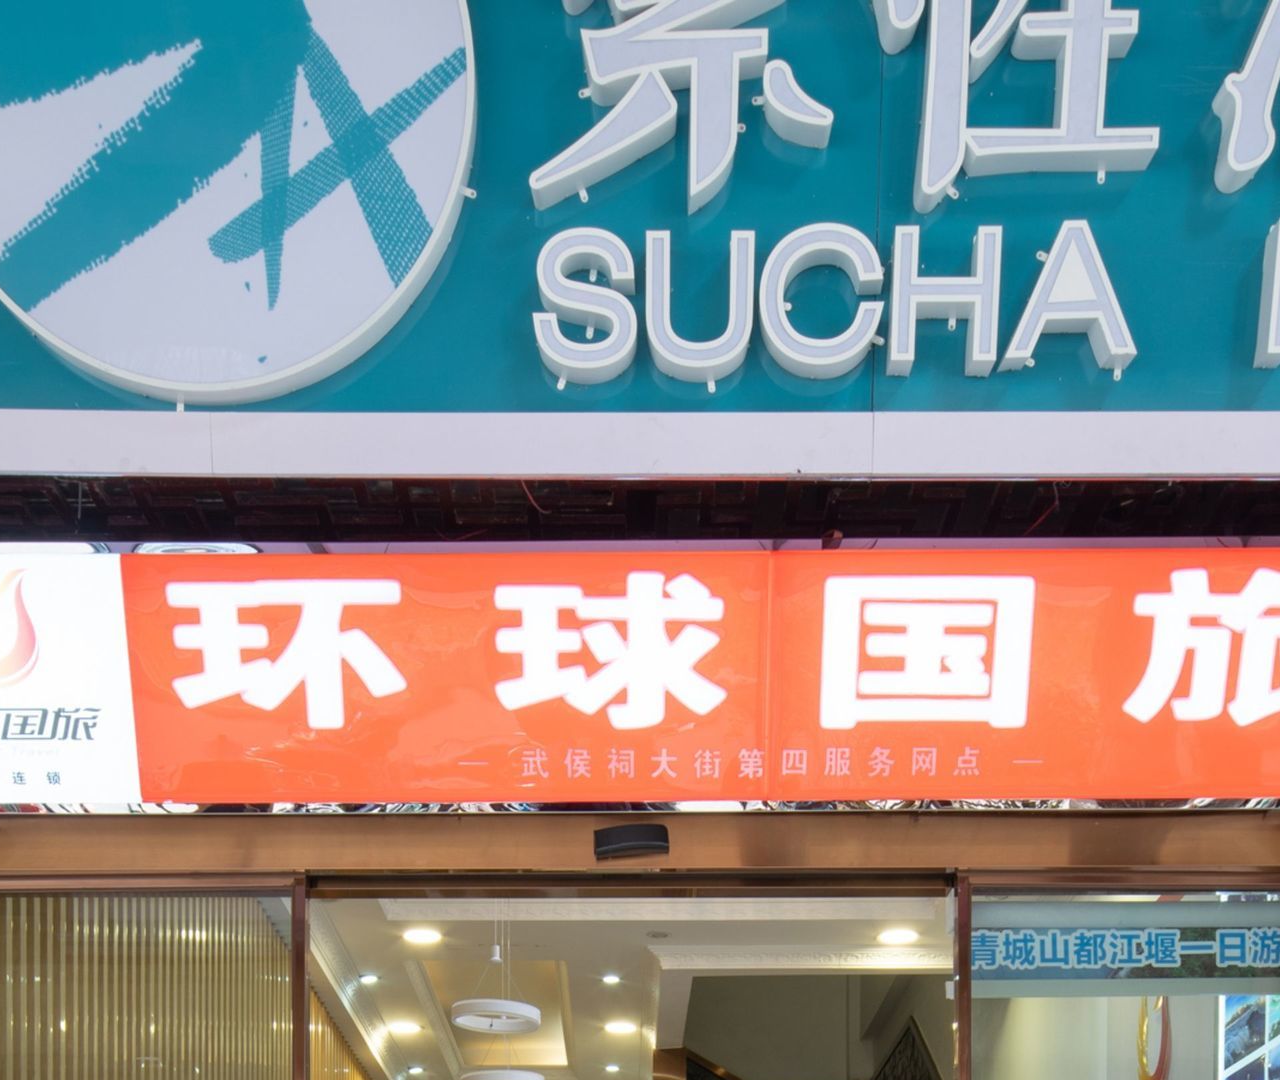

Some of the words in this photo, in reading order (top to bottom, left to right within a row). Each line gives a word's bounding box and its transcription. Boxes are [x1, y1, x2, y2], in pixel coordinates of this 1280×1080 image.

[533, 221, 1136, 382] SUCHA
[520, 747, 981, 779] 武侯祠大街第四服务网点
